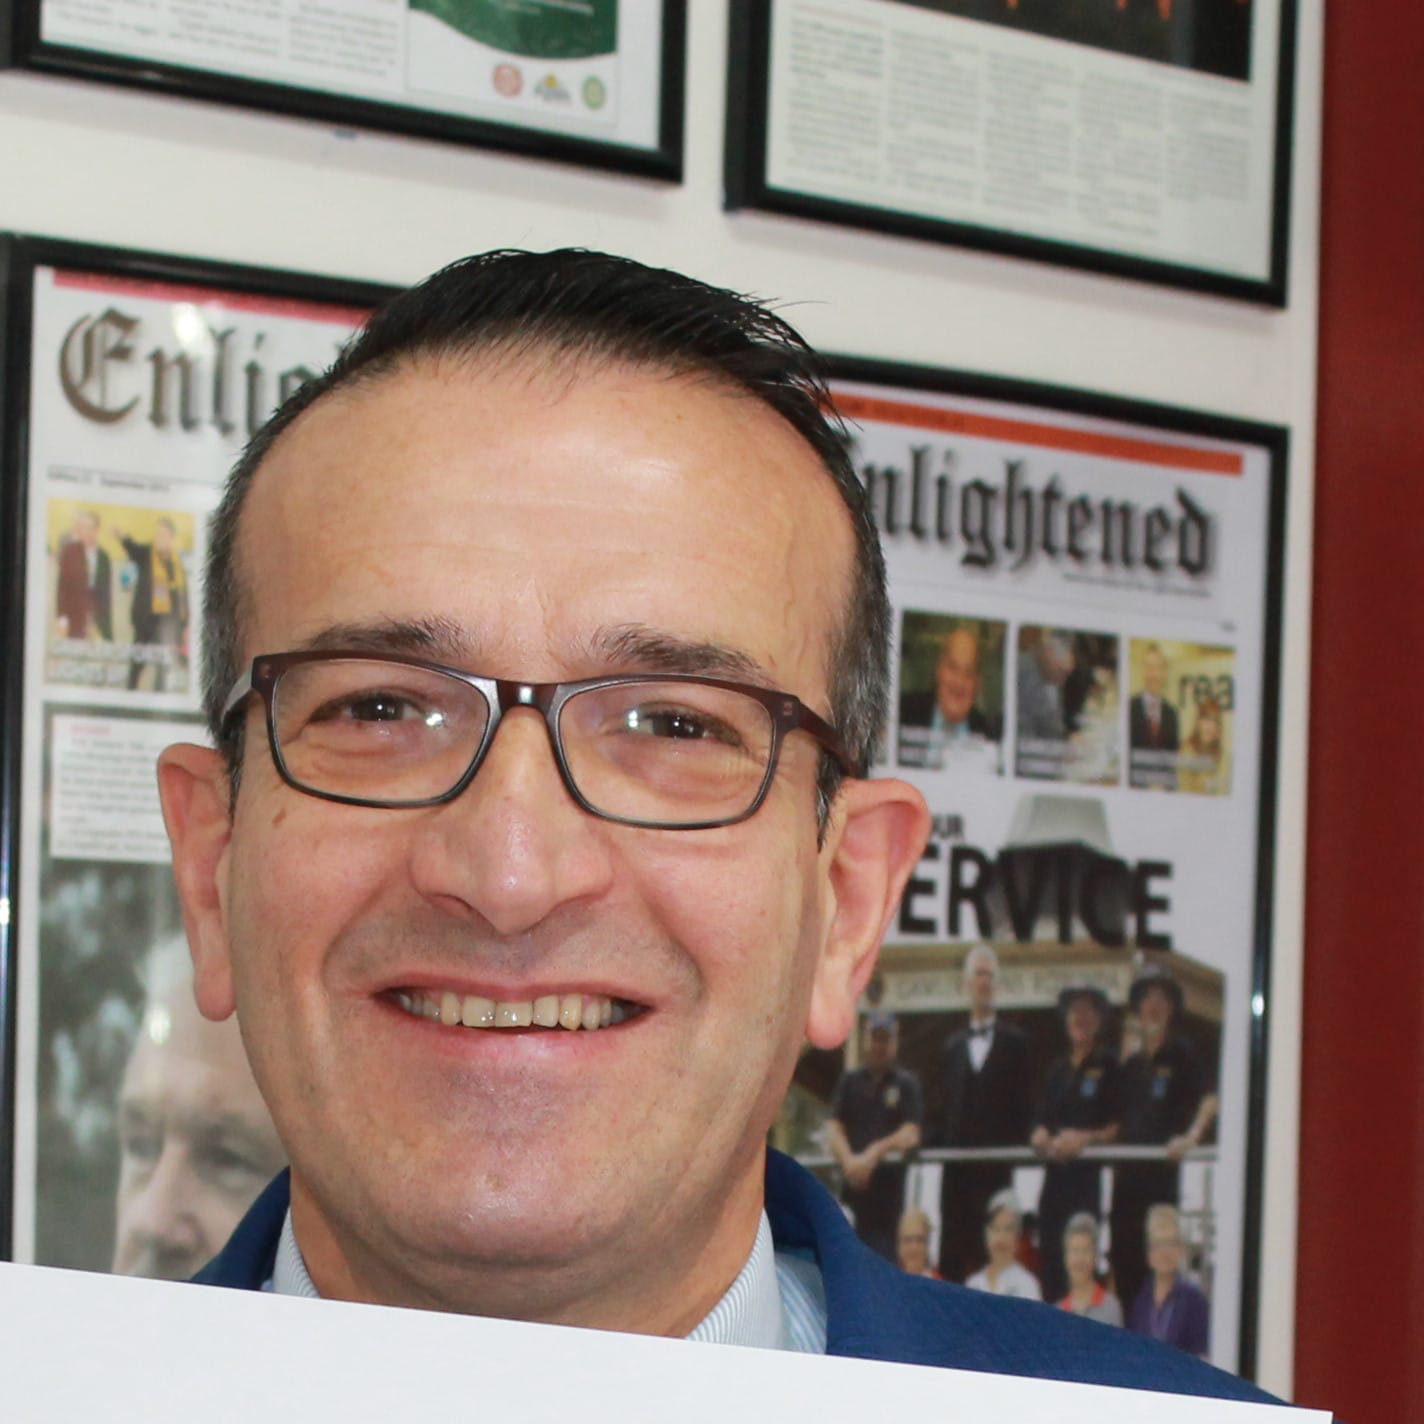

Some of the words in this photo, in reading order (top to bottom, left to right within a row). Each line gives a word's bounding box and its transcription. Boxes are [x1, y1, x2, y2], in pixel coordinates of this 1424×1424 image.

[59, 306, 331, 436] Enli
[862, 443, 1209, 577] nlightened
[931, 813, 963, 838] UR
[899, 844, 1173, 948] ERVICE
